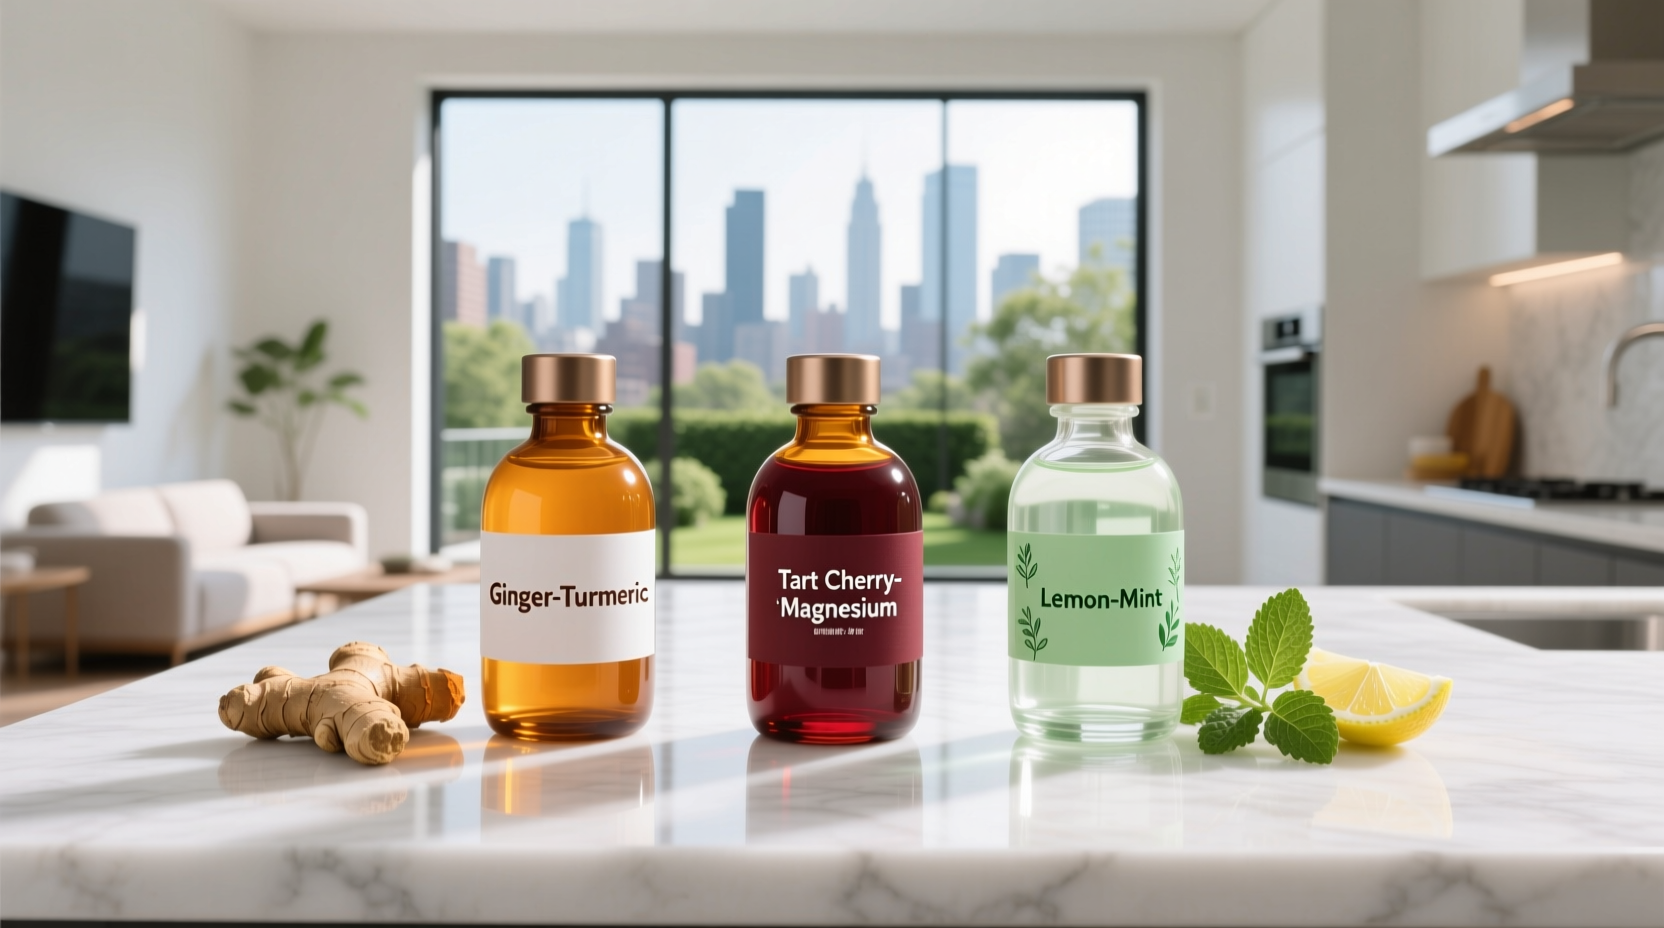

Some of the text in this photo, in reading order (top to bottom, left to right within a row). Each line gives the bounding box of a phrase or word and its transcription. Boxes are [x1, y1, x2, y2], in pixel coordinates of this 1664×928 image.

[777, 568, 902, 595] Tart Cherry-
[489, 582, 649, 613] Ginger-Turmeric
[1040, 587, 1163, 609] Lemon-Mint
